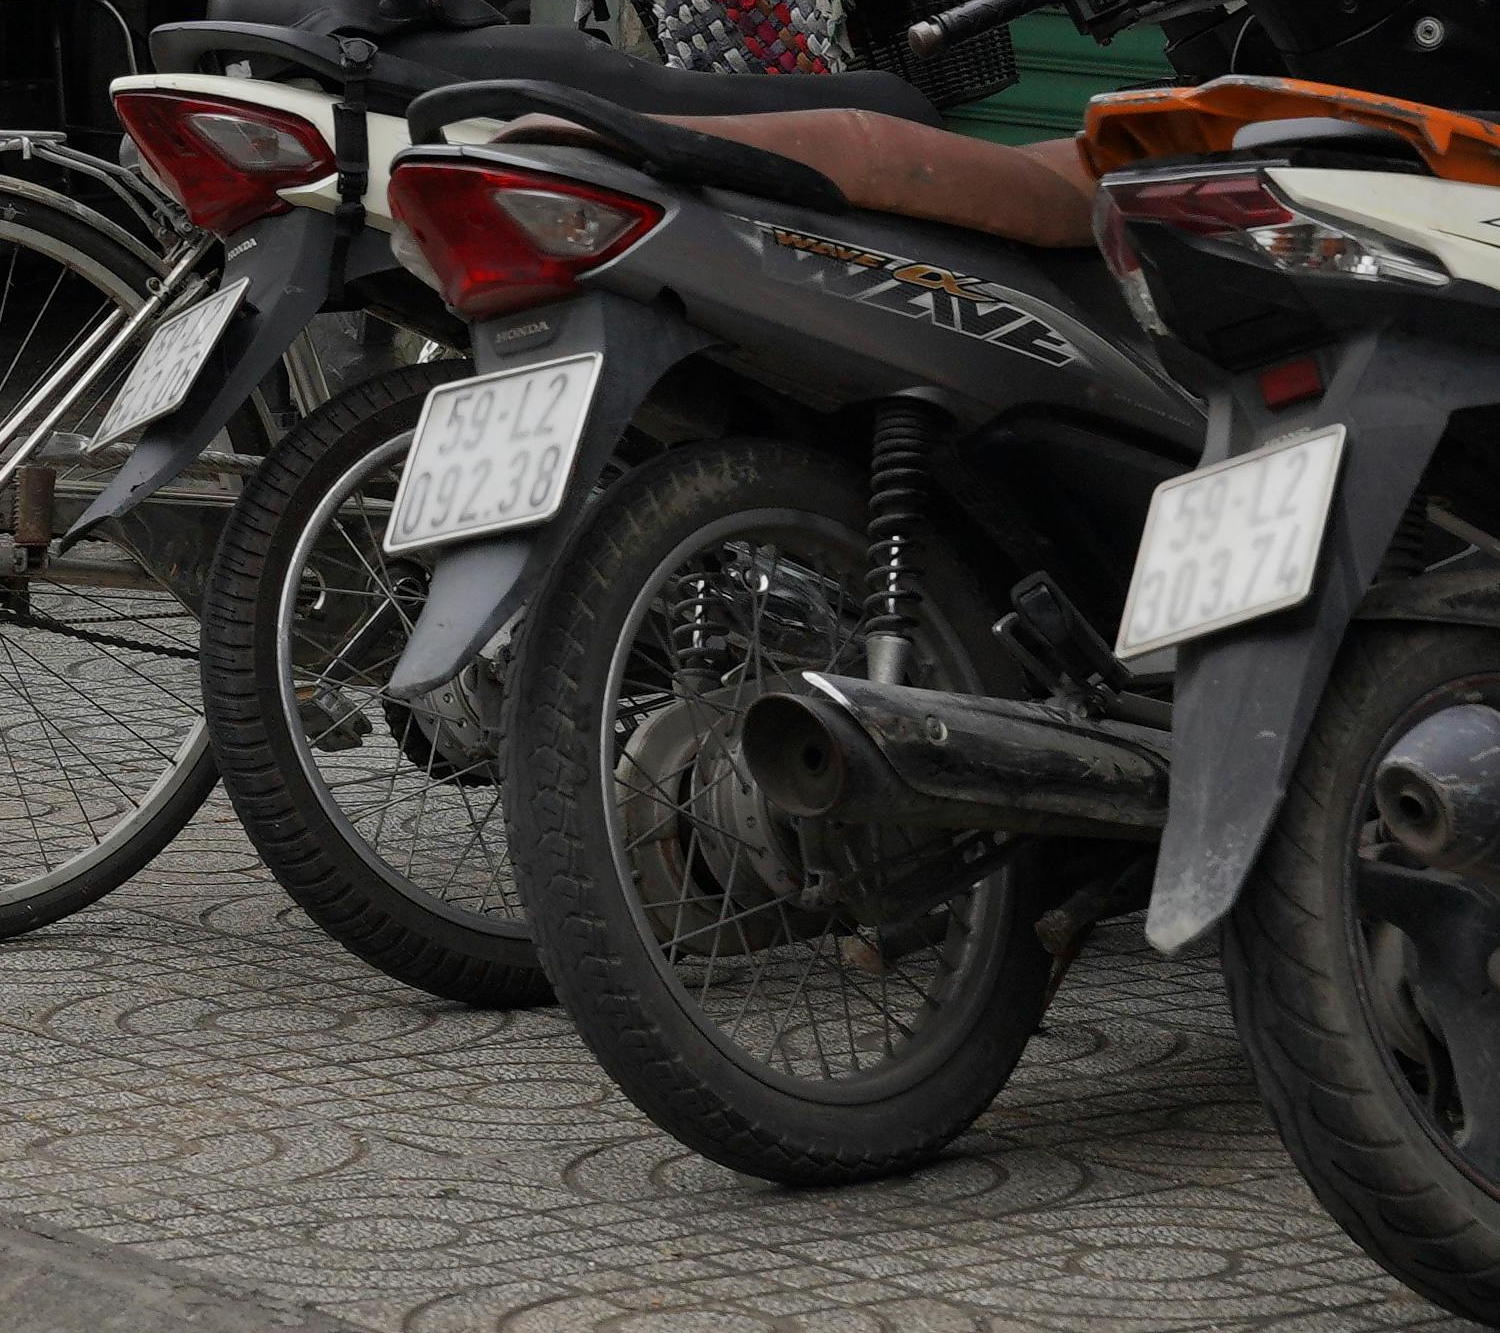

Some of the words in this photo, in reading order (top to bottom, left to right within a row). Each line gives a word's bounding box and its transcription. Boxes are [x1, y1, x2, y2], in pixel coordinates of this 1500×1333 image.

[227, 237, 258, 262] HONDA
[495, 320, 550, 344] HONDA
[438, 372, 569, 456] 59-L2
[402, 444, 561, 534] 092.38
